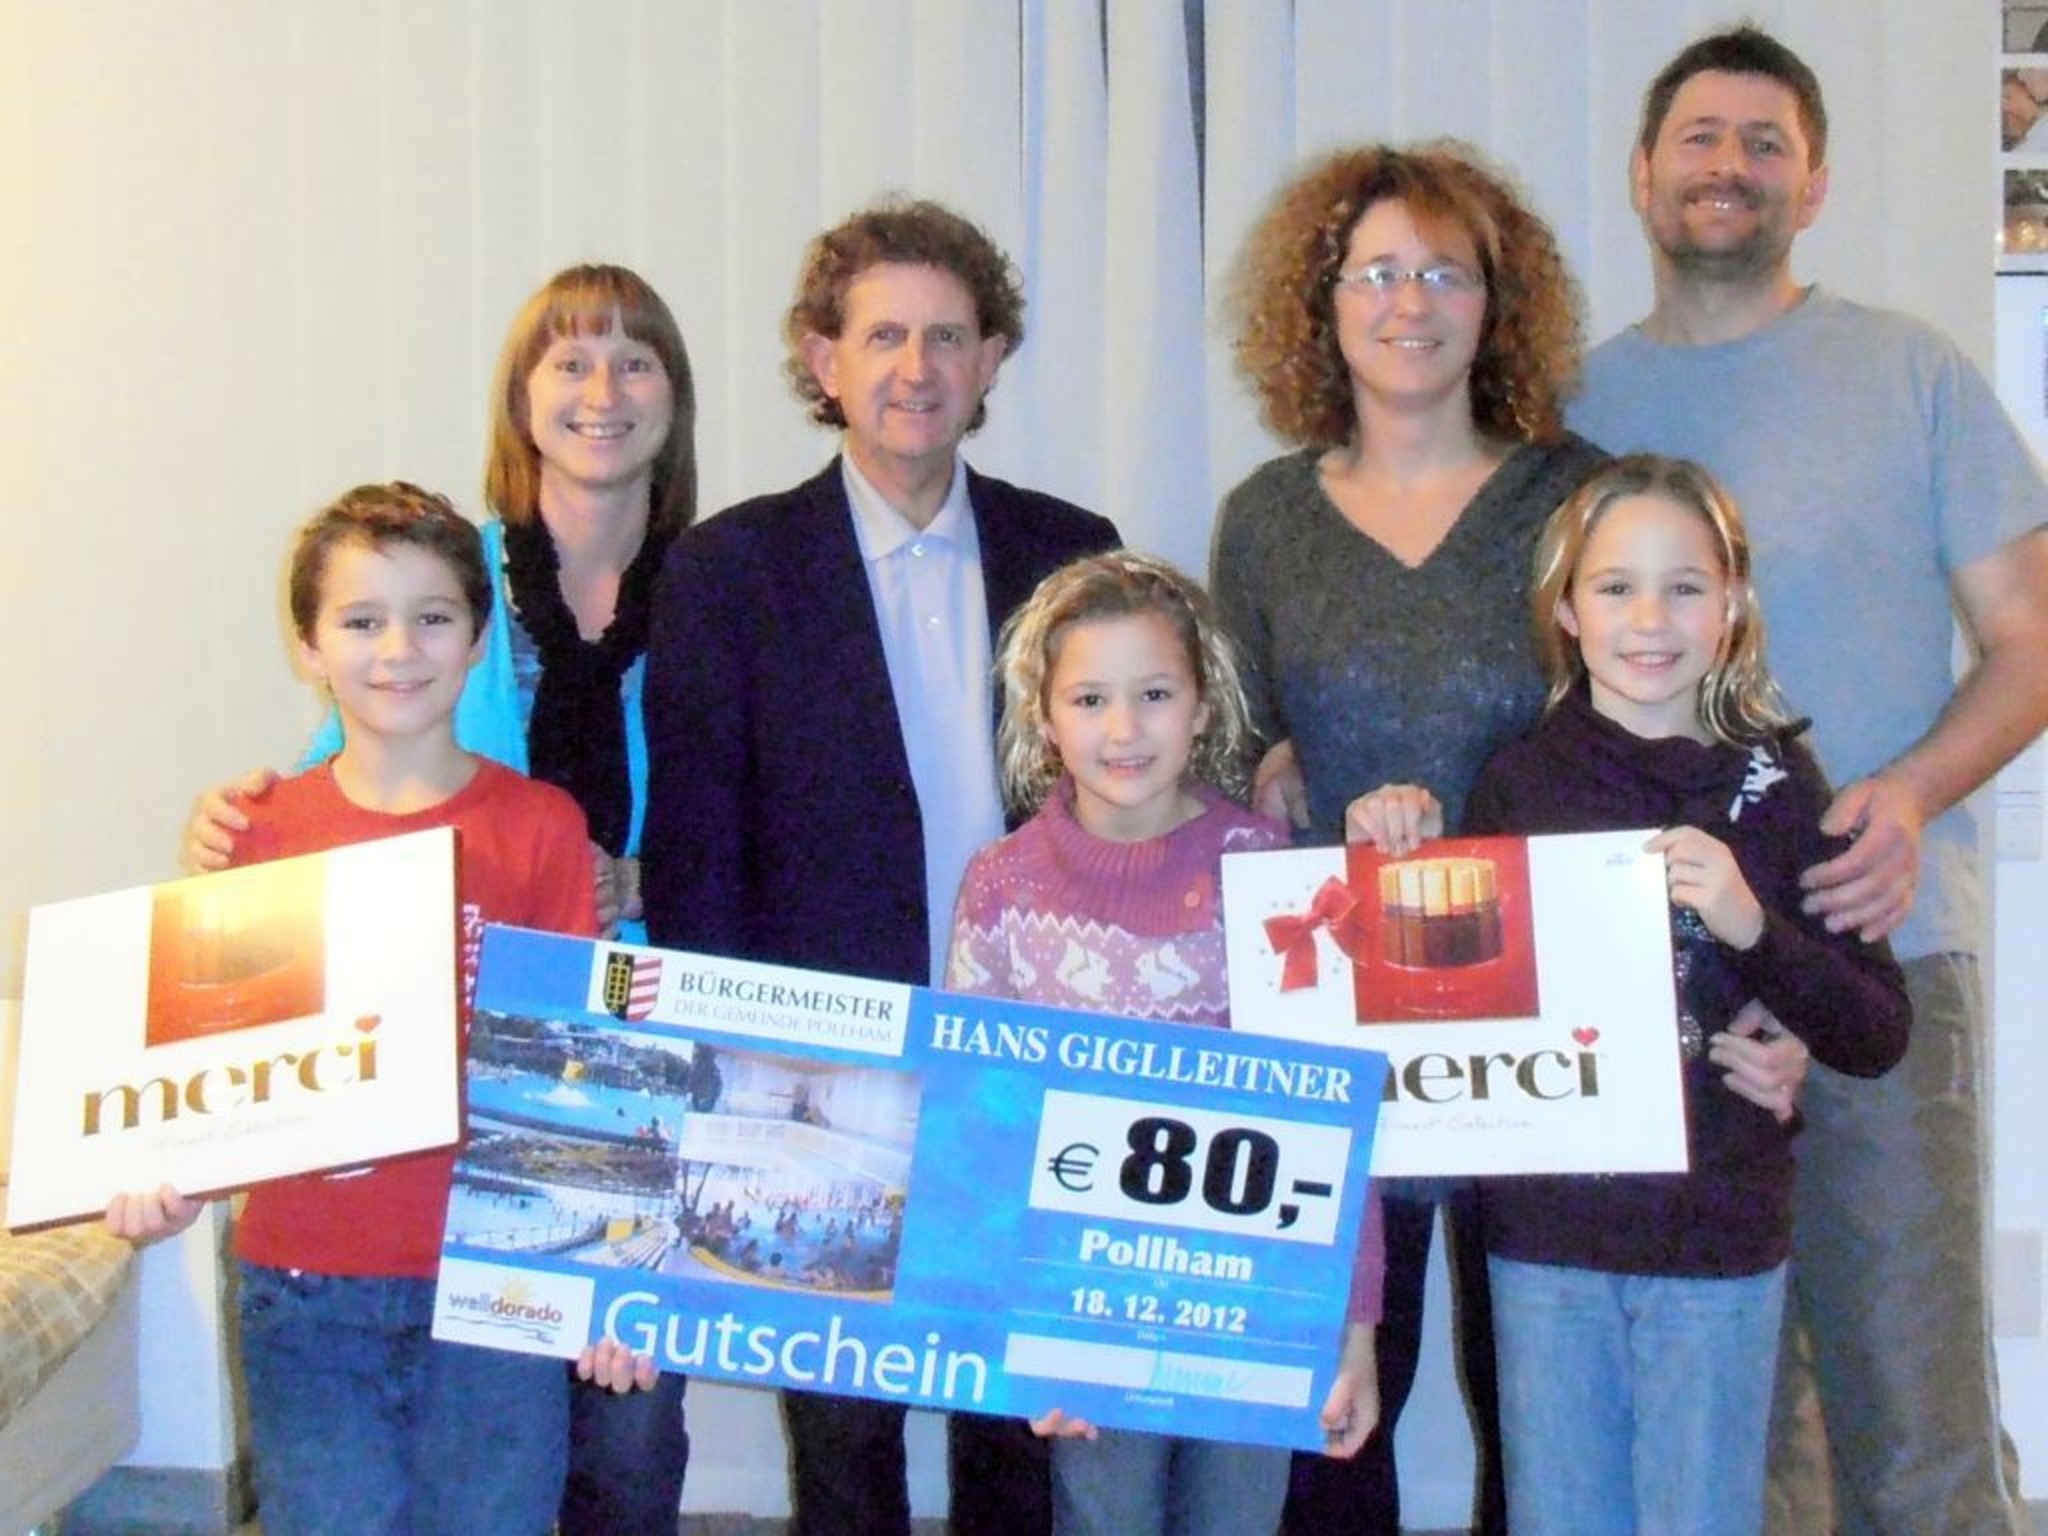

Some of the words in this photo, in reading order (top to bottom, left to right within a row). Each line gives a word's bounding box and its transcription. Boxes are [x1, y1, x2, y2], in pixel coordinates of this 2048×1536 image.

[674, 1000, 707, 1017] DER
[712, 1006, 800, 1031] GEMEINDE
[807, 1018, 892, 1042] POLLHAM
[679, 970, 893, 1022] BÜRGERMEISTER
[82, 1014, 382, 1137] merci
[930, 1013, 1049, 1063] HANS
[1058, 1032, 1353, 1103] GIGLLEITNER
[1047, 1142, 1100, 1192] €
[1118, 1116, 1332, 1230] 80,-
[1079, 1228, 1254, 1281] Pollham
[449, 1293, 563, 1323] welldorado
[1071, 1287, 1113, 1317] 18.
[1123, 1294, 1165, 1323] 12.
[1173, 1297, 1248, 1333] 2012
[604, 1290, 988, 1402] Gutschein
